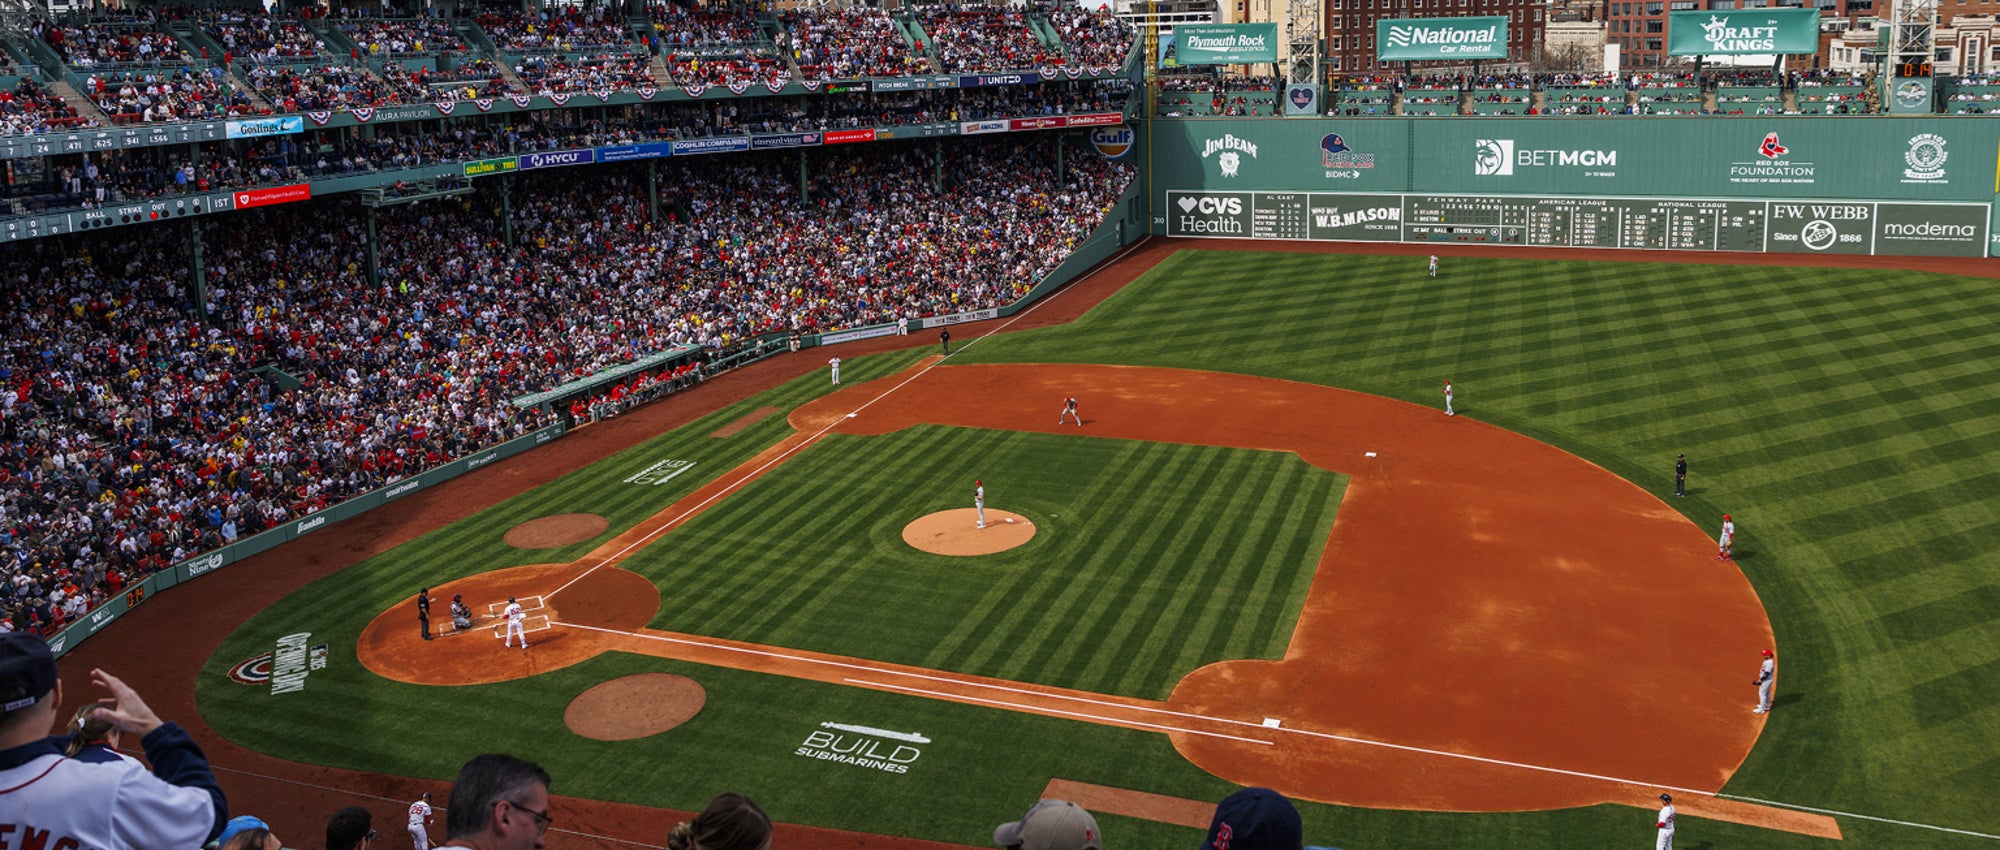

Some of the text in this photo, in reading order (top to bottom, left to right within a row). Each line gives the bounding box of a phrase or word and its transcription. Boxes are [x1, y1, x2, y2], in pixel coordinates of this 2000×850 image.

[1188, 34, 1265, 47] Plymouth Rock
[1705, 26, 1777, 42] DRAFT
[1459, 44, 1491, 52] Rental
[1713, 39, 1774, 51] KINGS
[988, 75, 1021, 85] UNITED
[376, 110, 431, 122] AURA PAVILION
[241, 123, 279, 135] Goslings
[1093, 130, 1131, 144] Gulf
[38, 145, 49, 153] 24
[66, 142, 82, 150] .471
[94, 140, 112, 148] .625
[124, 138, 139, 146] .941
[1202, 134, 1258, 158] JIM BEAM
[546, 153, 577, 164] HYCU
[1518, 150, 1616, 166] BETMGM
[1731, 167, 1814, 176] FOUNDATION
[118, 206, 143, 215] STRIKE
[1199, 197, 1242, 214] CVS
[86, 211, 105, 220] BALL
[1811, 206, 1869, 219] WEBB
[1180, 216, 1242, 233] Health
[1884, 222, 1975, 236] moderna
[1774, 232, 1862, 243] Since 1866
[386, 480, 419, 498] smartwater
[297, 516, 325, 534] Franklin
[190, 565, 209, 576] Nine
[271, 671, 309, 695] DAY
[803, 731, 920, 763] BUILD
[794, 747, 909, 774] SUBMARINES
